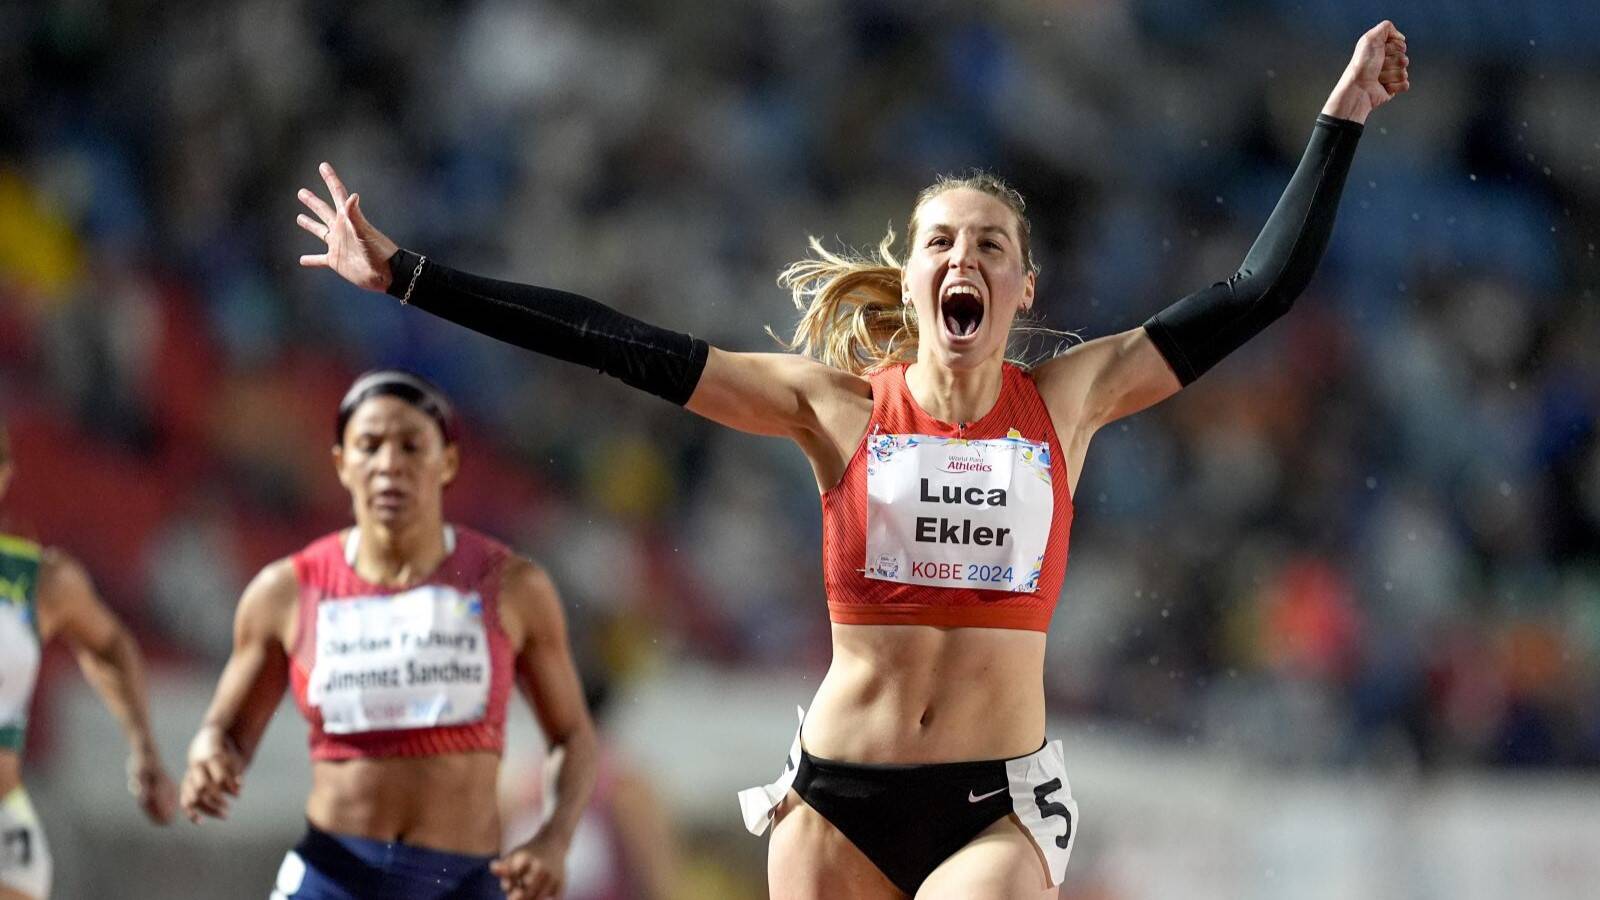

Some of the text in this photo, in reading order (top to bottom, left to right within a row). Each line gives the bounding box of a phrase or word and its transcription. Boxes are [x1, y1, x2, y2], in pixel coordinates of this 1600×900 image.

[947, 461, 993, 472] Athletics
[919, 478, 1007, 507] Luca
[915, 516, 1011, 546] Ekler
[911, 561, 963, 580] KOBE
[967, 564, 1014, 583] 2024
[1033, 777, 1072, 849] 5
